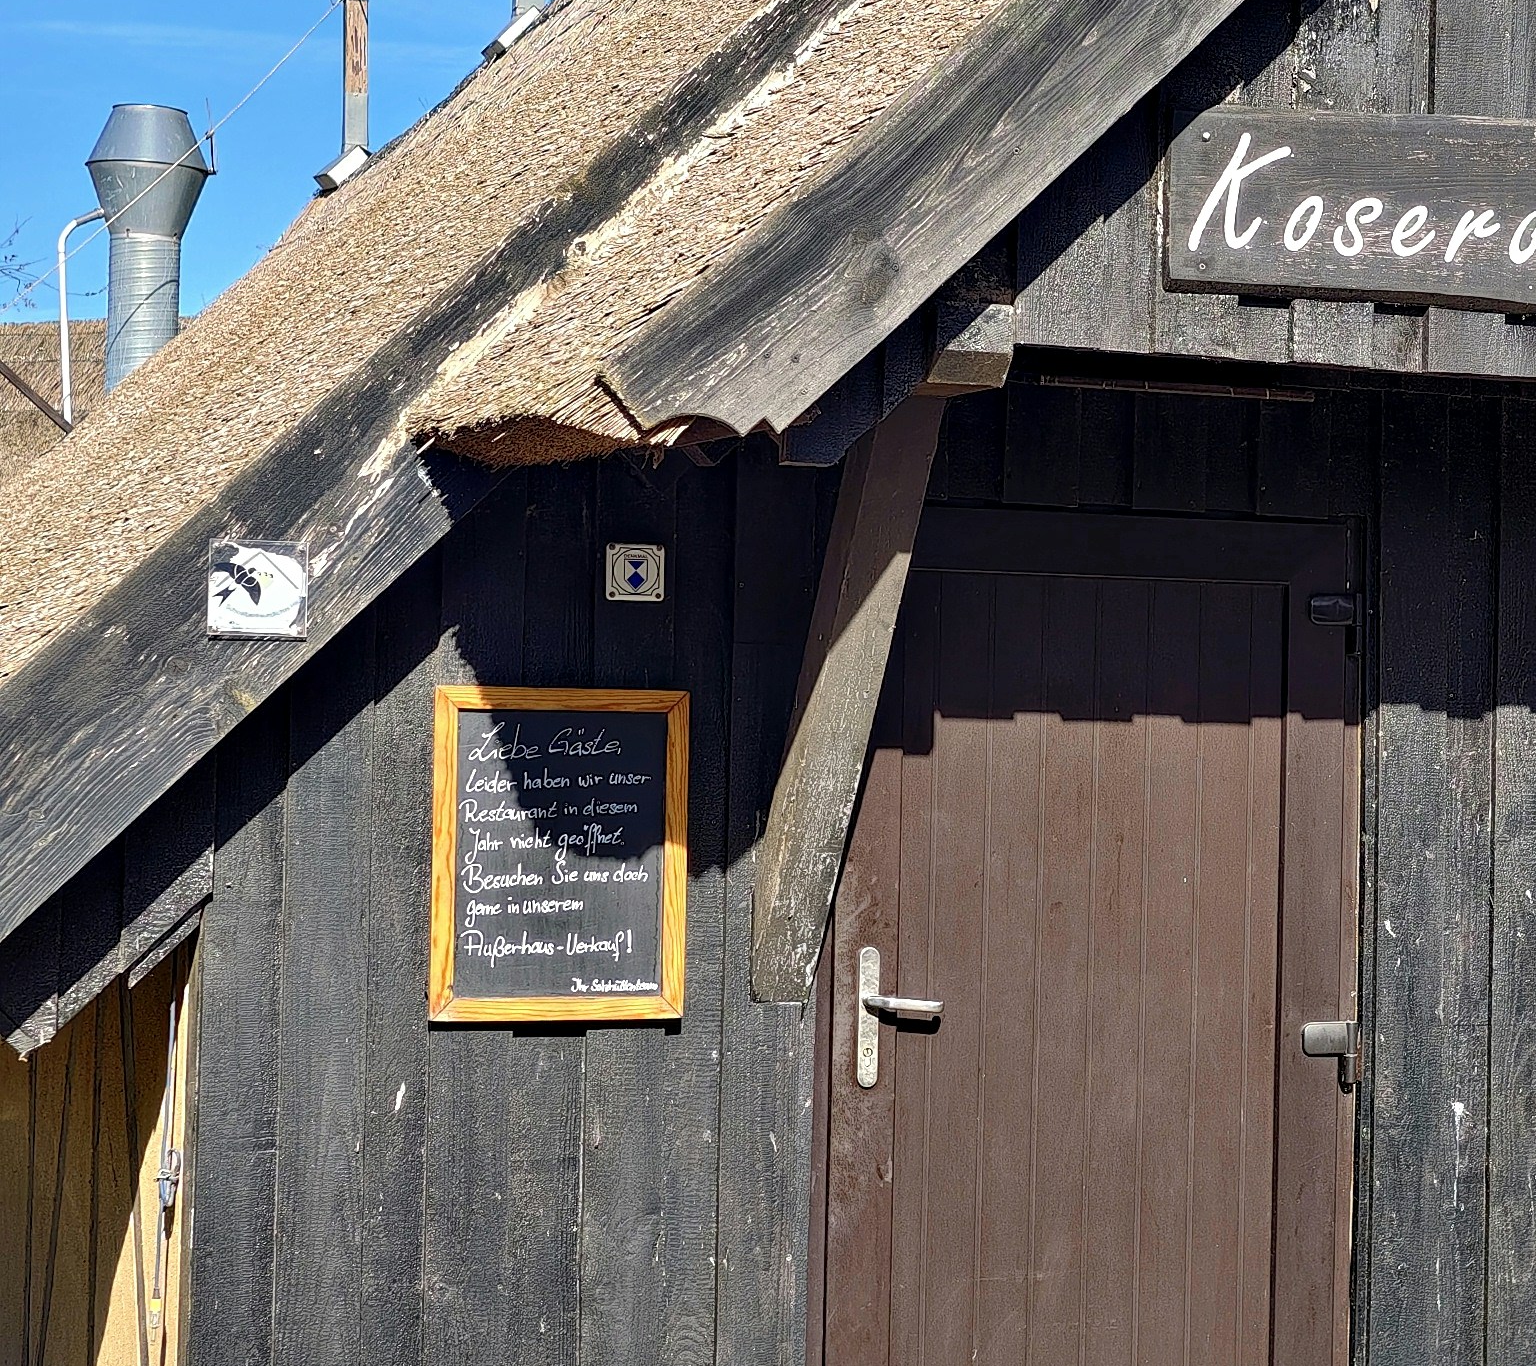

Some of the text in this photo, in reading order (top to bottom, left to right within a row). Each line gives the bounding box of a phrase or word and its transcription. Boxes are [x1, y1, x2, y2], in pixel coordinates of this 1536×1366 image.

[468, 721, 621, 762] Liebe Gäste,
[523, 767, 570, 789] haben
[578, 771, 603, 787] wir
[609, 771, 651, 785] unser
[459, 797, 638, 823] Restaurant in diesem
[464, 822, 625, 864] Jahr nicht geöffnet.
[460, 860, 649, 894] Besuchen Sie uns doch
[464, 896, 584, 928] gerne in unserem
